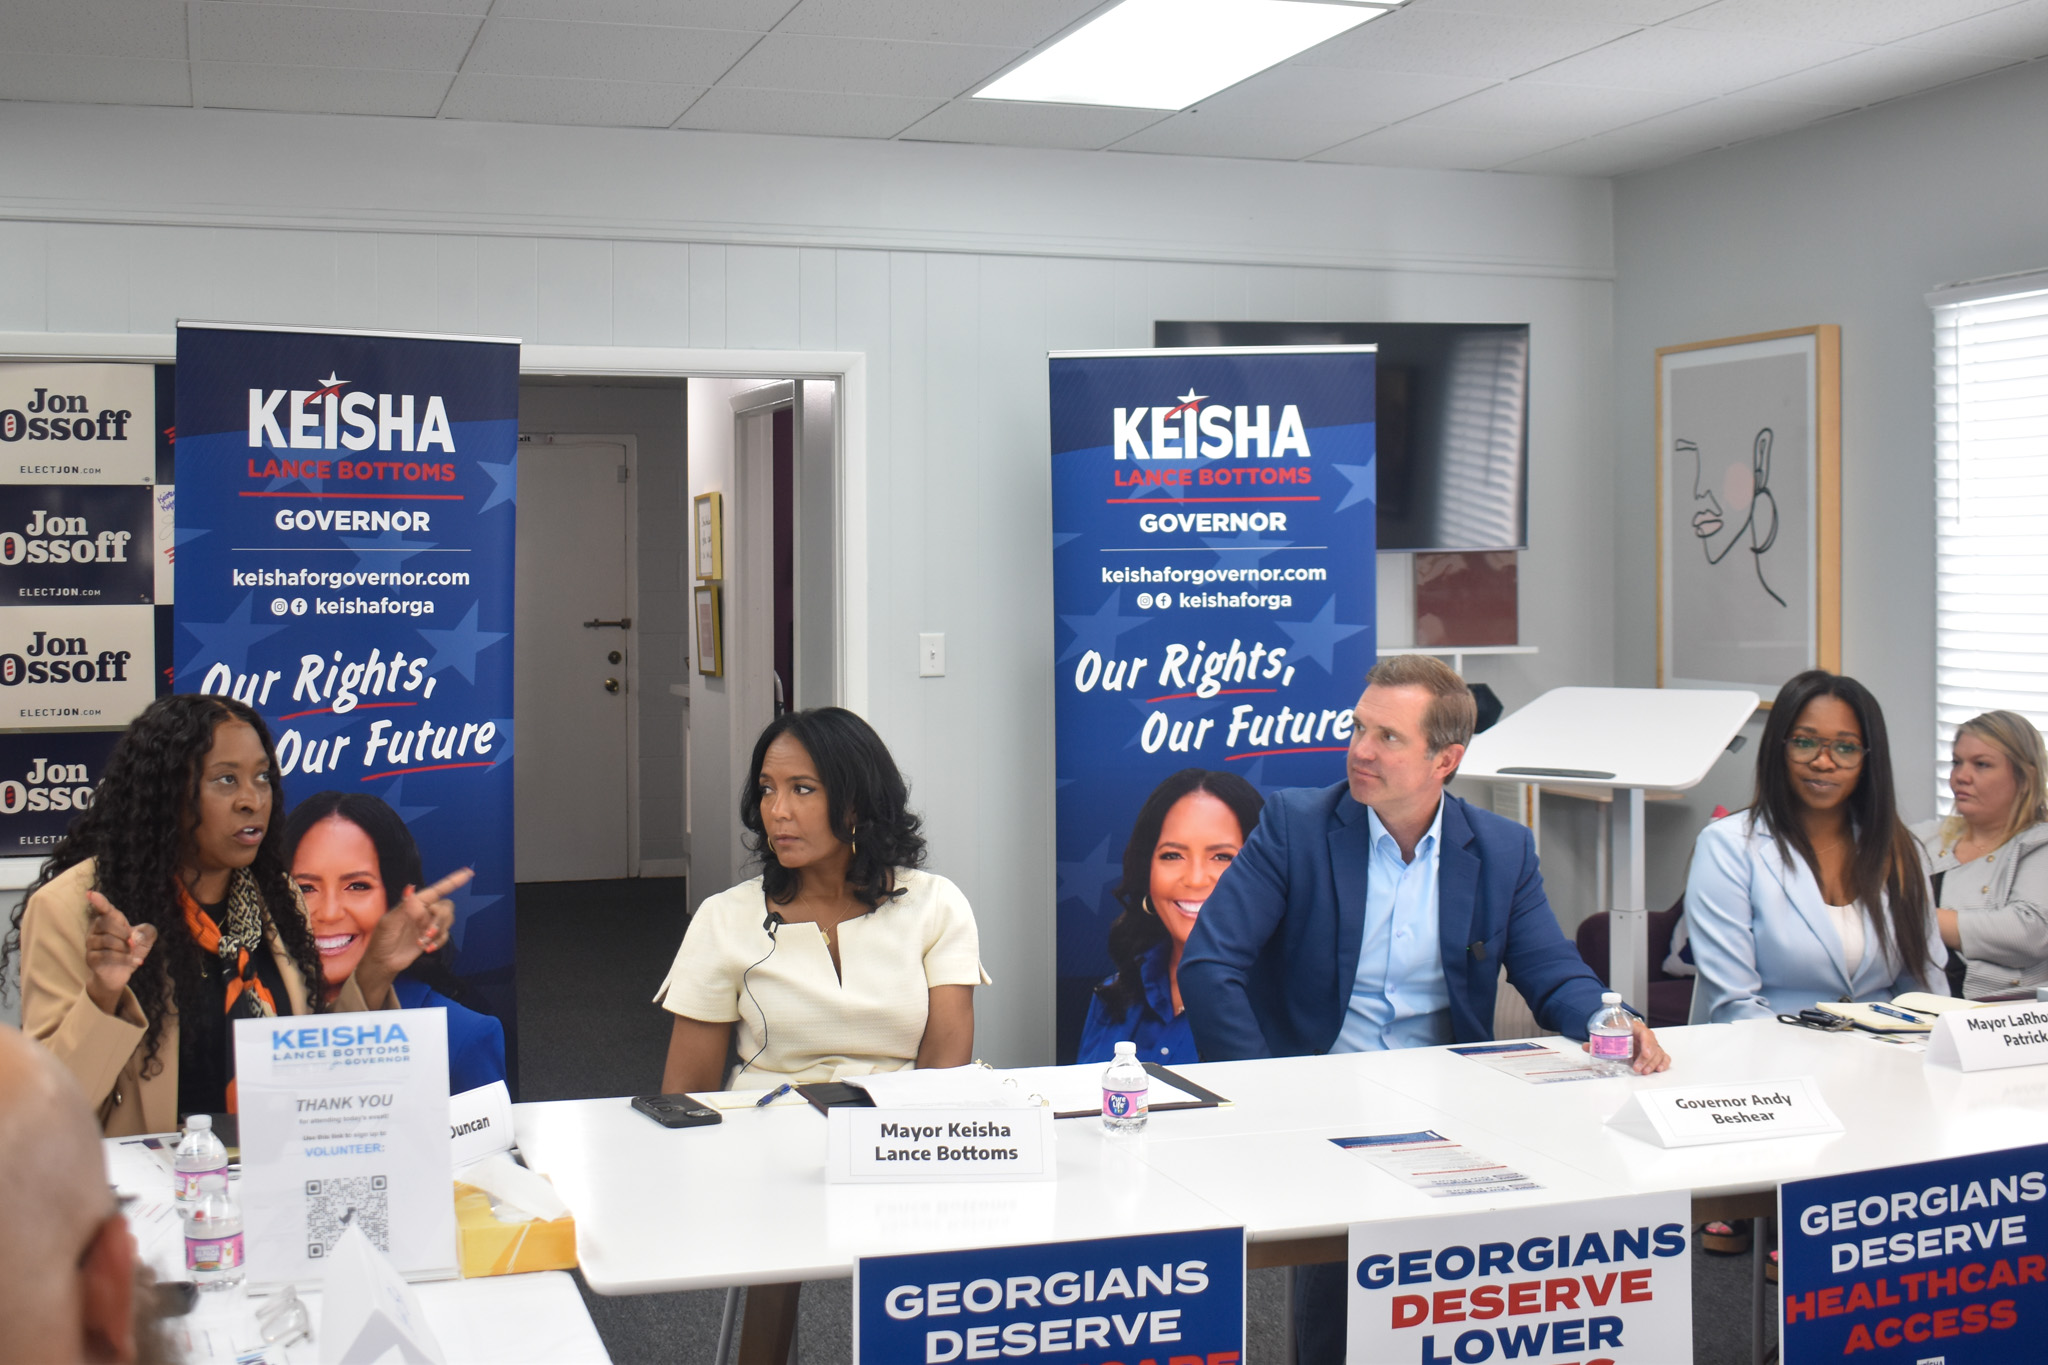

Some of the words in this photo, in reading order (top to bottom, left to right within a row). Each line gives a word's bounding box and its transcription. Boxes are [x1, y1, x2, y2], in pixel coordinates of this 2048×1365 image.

[27, 388, 89, 413] Jon
[0, 409, 132, 442] Ossoff
[249, 388, 456, 453] KEISHA
[1114, 404, 1311, 460] KEISHA
[20, 465, 102, 474] ELECTJON.COM
[248, 459, 331, 479] LANCE
[338, 461, 456, 482] BOTTOMS
[1114, 469, 1192, 487] LANCE
[1199, 467, 1312, 485] BOTTOMS
[26, 510, 89, 536] Jon
[275, 509, 430, 532] GOVERNOR
[1140, 512, 1287, 533] GOVERNOR
[0, 531, 132, 566] Ossoff
[233, 569, 470, 588] keishaforgovernor.com
[1102, 567, 1327, 584] keishaforgovernor.com
[19, 588, 101, 597] ELECTJON.COM
[1179, 592, 1292, 610] keishaforga
[316, 597, 434, 616] keishaforga
[26, 631, 89, 657] Jon
[0, 651, 132, 686] Ossoff
[200, 662, 281, 708] Our
[292, 648, 437, 714] Rights,
[1075, 649, 1147, 692] Our
[1158, 638, 1295, 698] Rights,
[20, 708, 102, 717] ELECTJON.COM
[1141, 710, 1214, 753] Our
[1226, 704, 1354, 748] Future
[275, 728, 350, 776] Our
[364, 719, 496, 766] Future
[26, 758, 89, 784] Jon
[0, 778, 105, 814] Osso
[1967, 1018, 2006, 1032] Mayor
[2007, 1011, 2048, 1027] LaRho
[272, 1023, 409, 1050] KEISHA
[2003, 1029, 2048, 1046] Patrick
[273, 1050, 327, 1061] LANCE
[333, 1045, 410, 1057] BOTTOMS
[344, 1055, 410, 1066] GOVERNOR
[296, 1095, 353, 1112] THANK
[358, 1094, 394, 1109] YOU
[1675, 1096, 1747, 1110] Governor
[1752, 1092, 1792, 1107] Andy
[1711, 1110, 1776, 1125] Beshear
[880, 1122, 943, 1143] Mayor
[948, 1121, 1011, 1139] Keisha
[875, 1145, 932, 1162] Lance
[937, 1144, 1019, 1162] Bottoms
[1800, 1171, 2047, 1236] GEORGIANS
[1356, 1223, 1686, 1290] GEORGIANS
[1832, 1215, 2027, 1274] DESERVE
[885, 1260, 1209, 1320] GEORGIANS
[1392, 1268, 1653, 1329] DESERVE
[1786, 1253, 2048, 1325] HEALTHCAR
[926, 1309, 1182, 1364] DESERVE
[1421, 1315, 1624, 1365] LOWER
[1843, 1299, 2018, 1355] ACCESS
